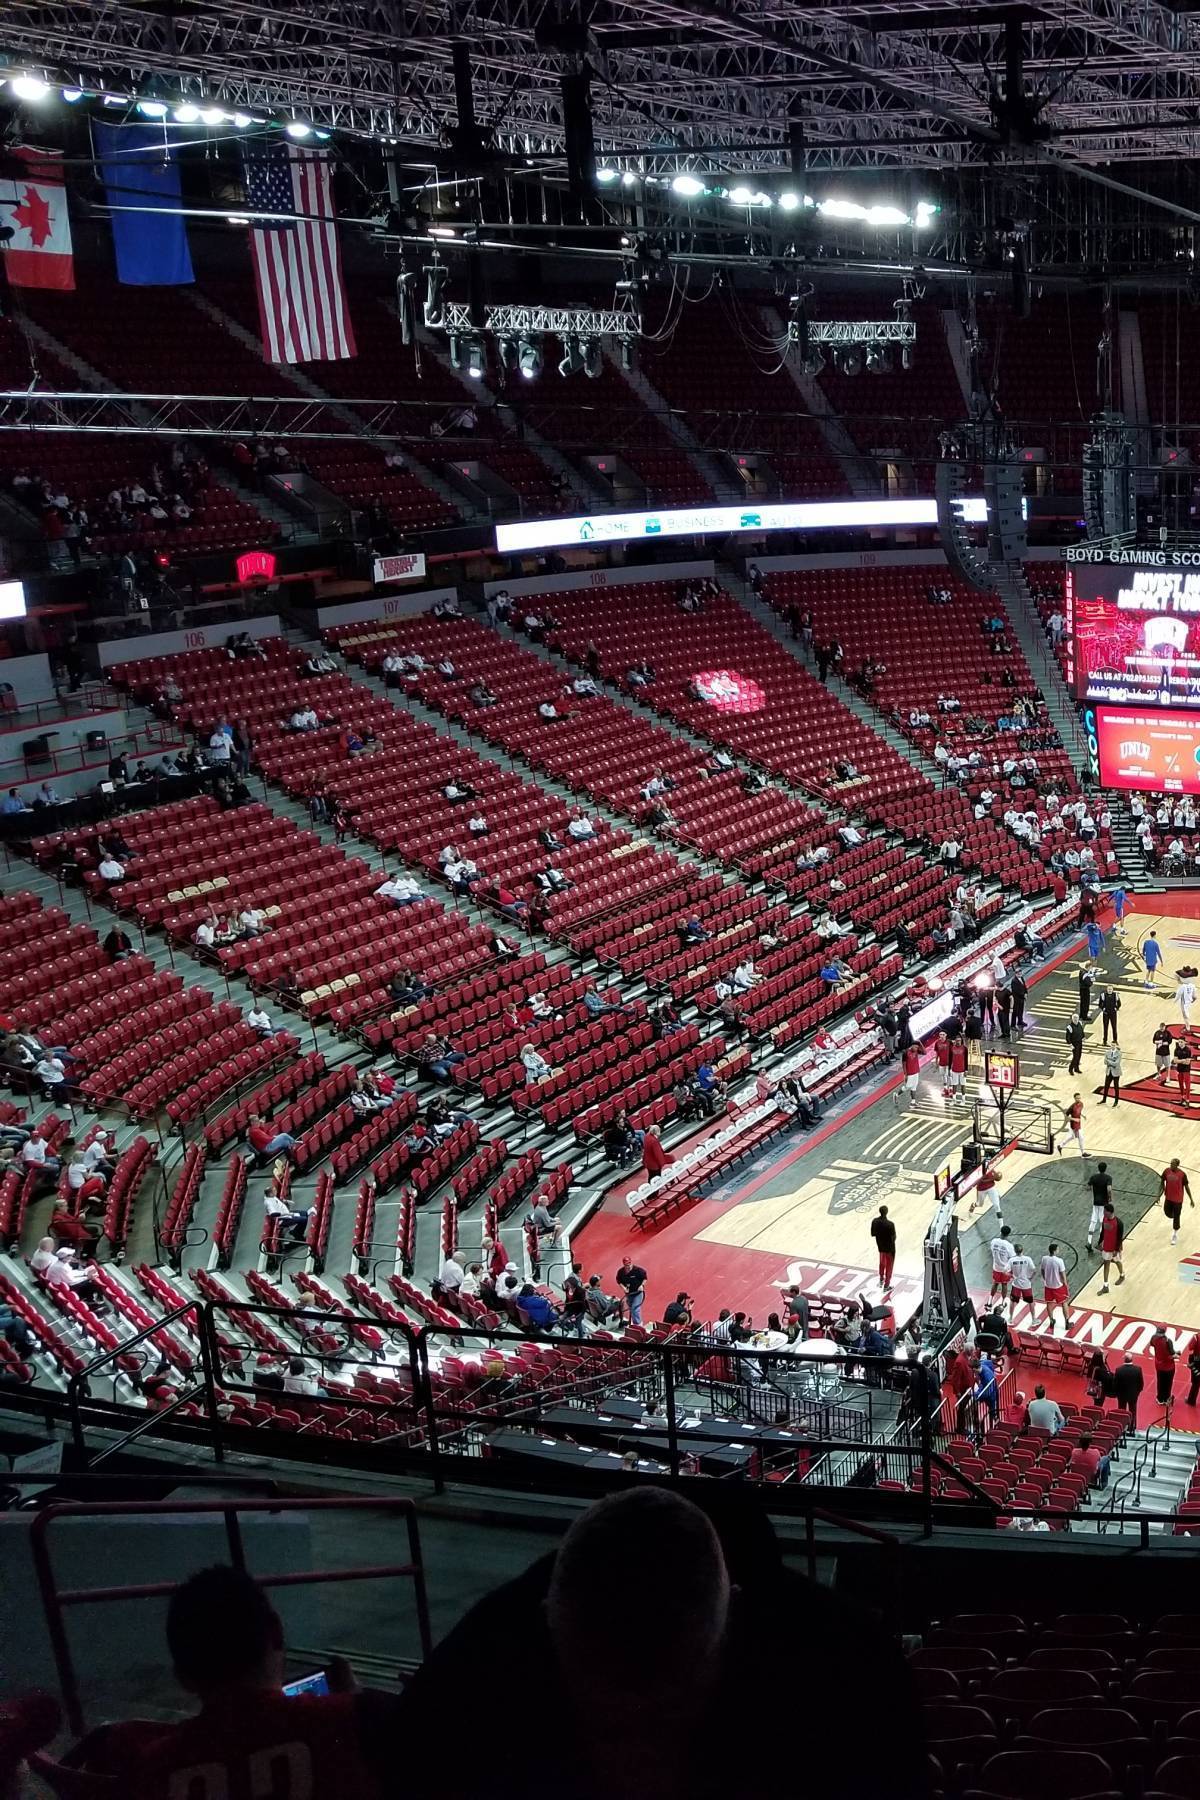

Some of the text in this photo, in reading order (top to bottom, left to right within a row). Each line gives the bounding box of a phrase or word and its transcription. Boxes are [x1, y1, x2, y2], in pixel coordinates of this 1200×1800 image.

[1066, 549, 1104, 562] BOYD
[1110, 549, 1166, 565] GAMING
[383, 600, 400, 615] 107
[184, 632, 206, 648] 106
[1088, 671, 1103, 680] CALL
[1085, 709, 1099, 777] COX
